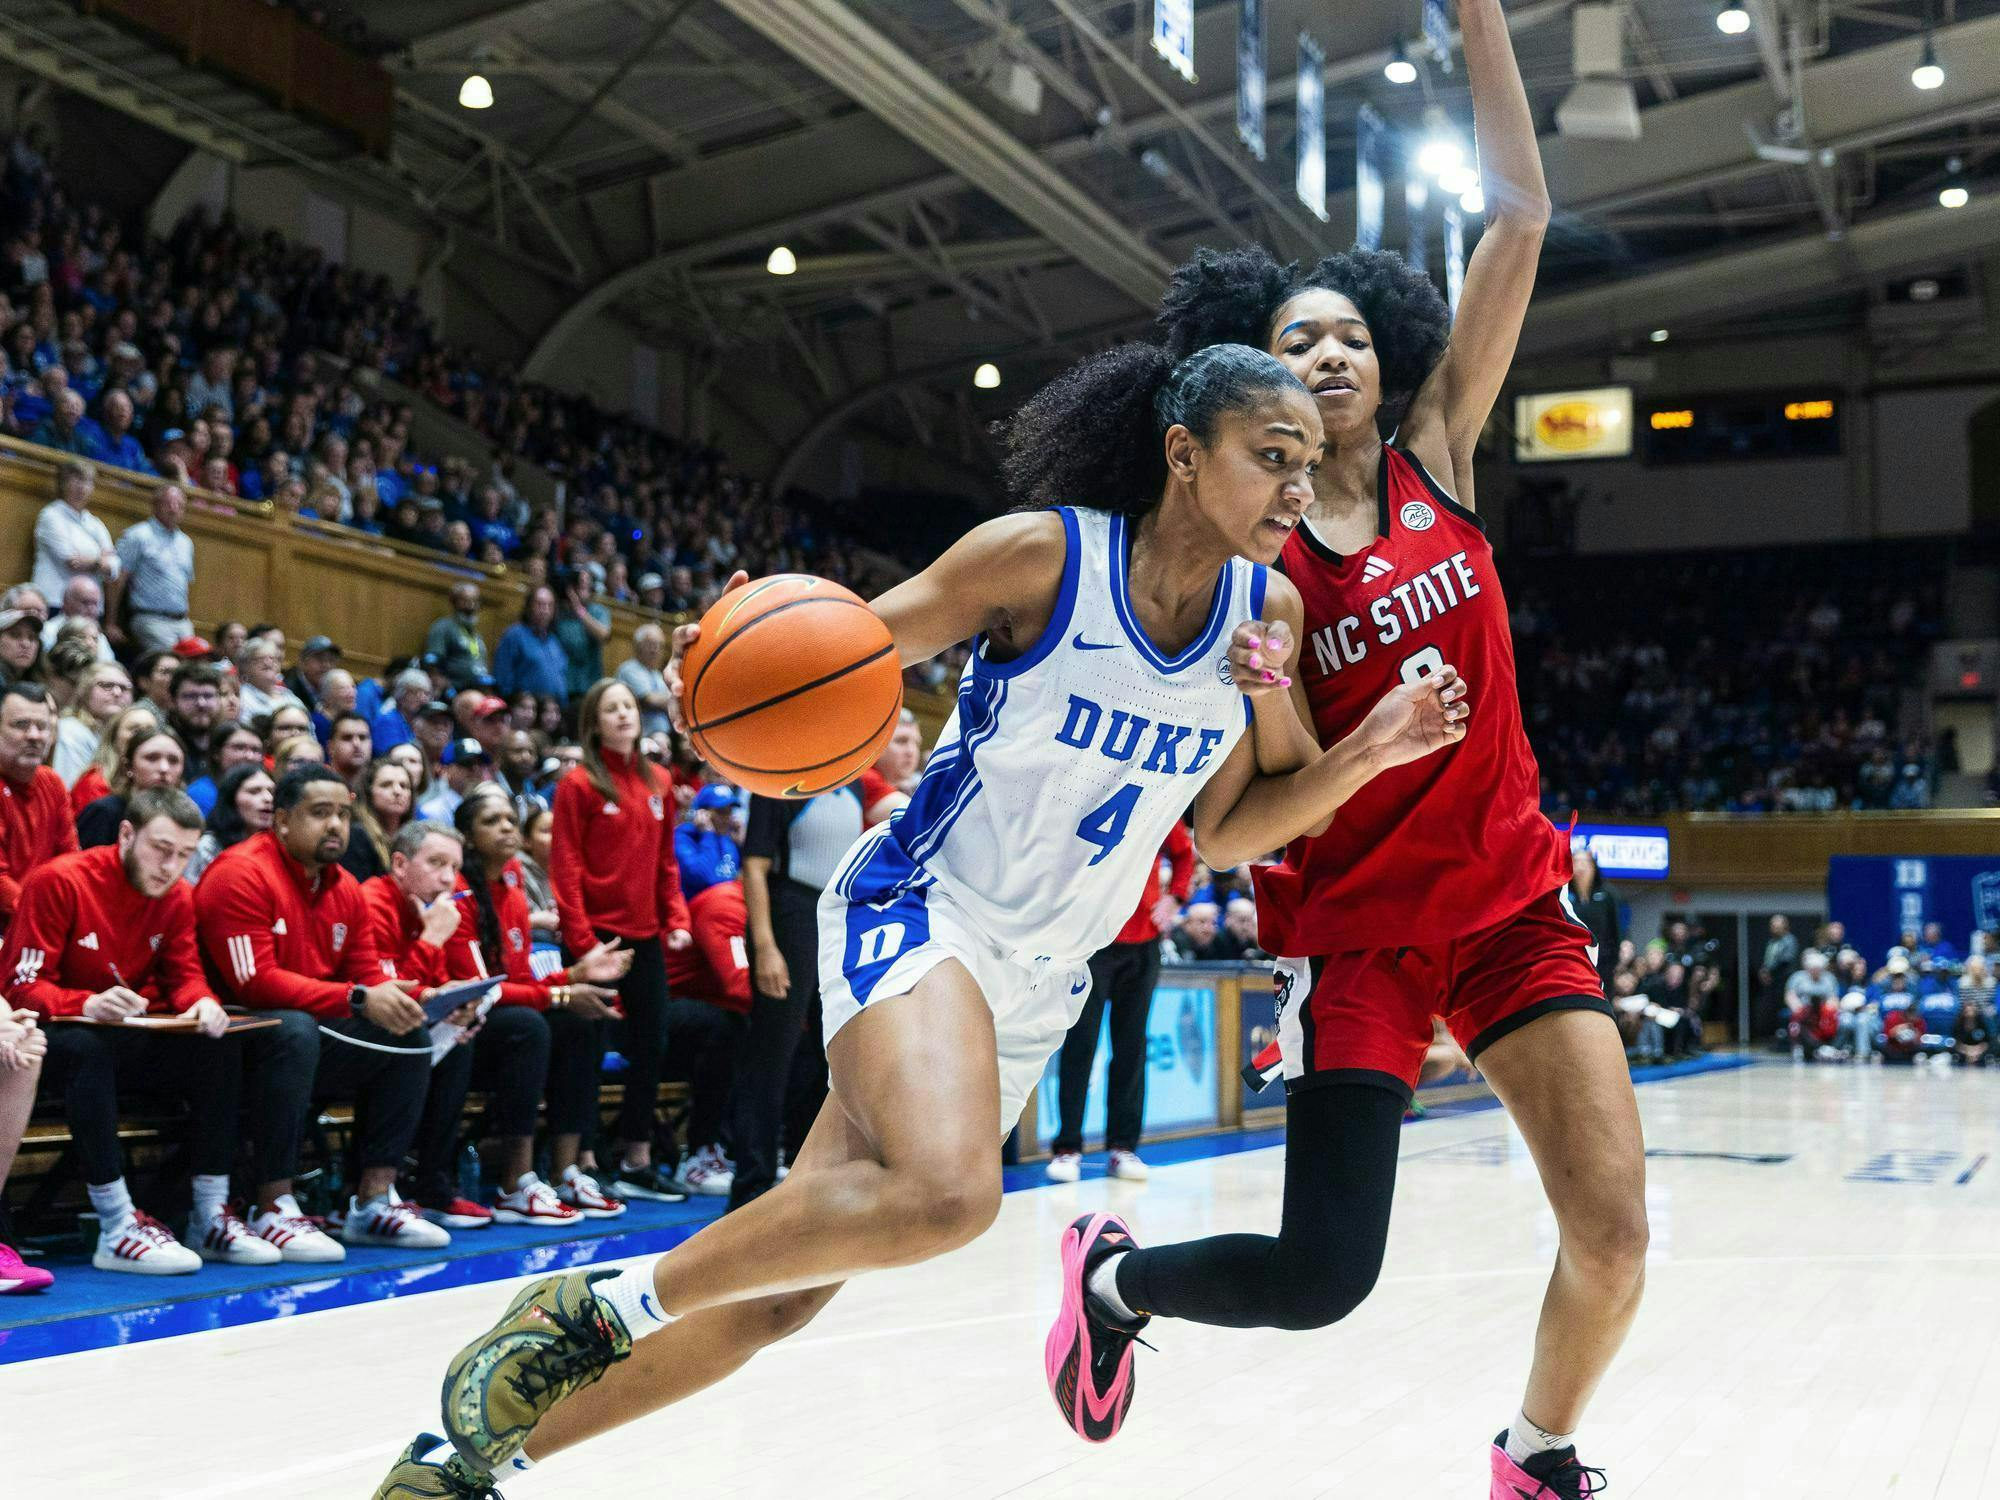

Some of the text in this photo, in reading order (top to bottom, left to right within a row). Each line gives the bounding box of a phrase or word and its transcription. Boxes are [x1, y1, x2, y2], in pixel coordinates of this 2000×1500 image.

[1408, 508, 1429, 522] ACC
[1311, 614, 1368, 677] NC
[1370, 550, 1481, 645] STATE
[1054, 693, 1225, 775] DUKE
[1075, 782, 1144, 867] 4
[855, 922, 906, 969] D
